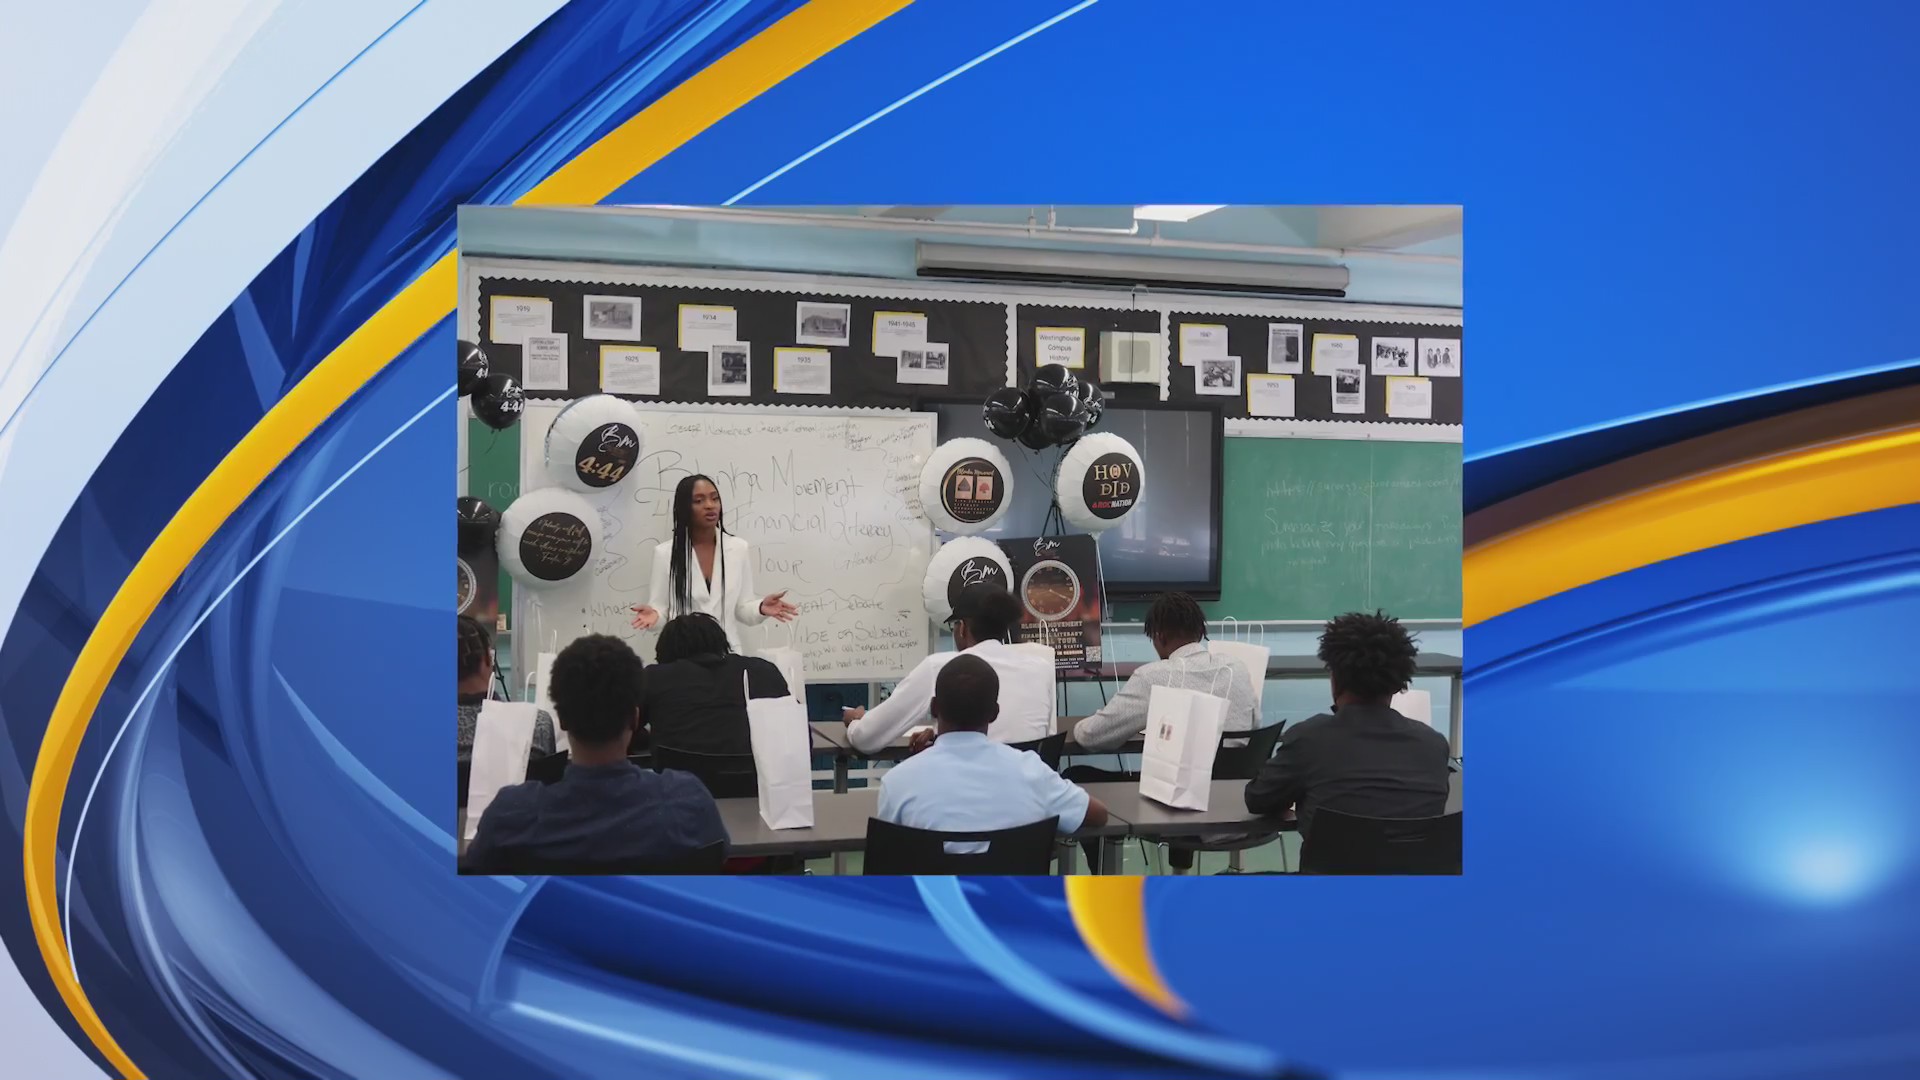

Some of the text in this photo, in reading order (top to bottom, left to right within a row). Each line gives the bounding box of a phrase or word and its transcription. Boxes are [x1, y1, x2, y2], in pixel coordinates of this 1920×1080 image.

[515, 304, 531, 312] 1919
[702, 313, 717, 321] 1934
[887, 319, 916, 329] 1941-1945
[1038, 334, 1081, 344] Westinghouse
[1047, 344, 1072, 352] Campus
[624, 354, 640, 363] 1925
[797, 356, 812, 364] 1935
[577, 456, 626, 483] 4:44
[1094, 462, 1132, 480] HOV
[771, 448, 865, 507] Movement
[1101, 480, 1131, 498] DID
[720, 497, 828, 537] Financial
